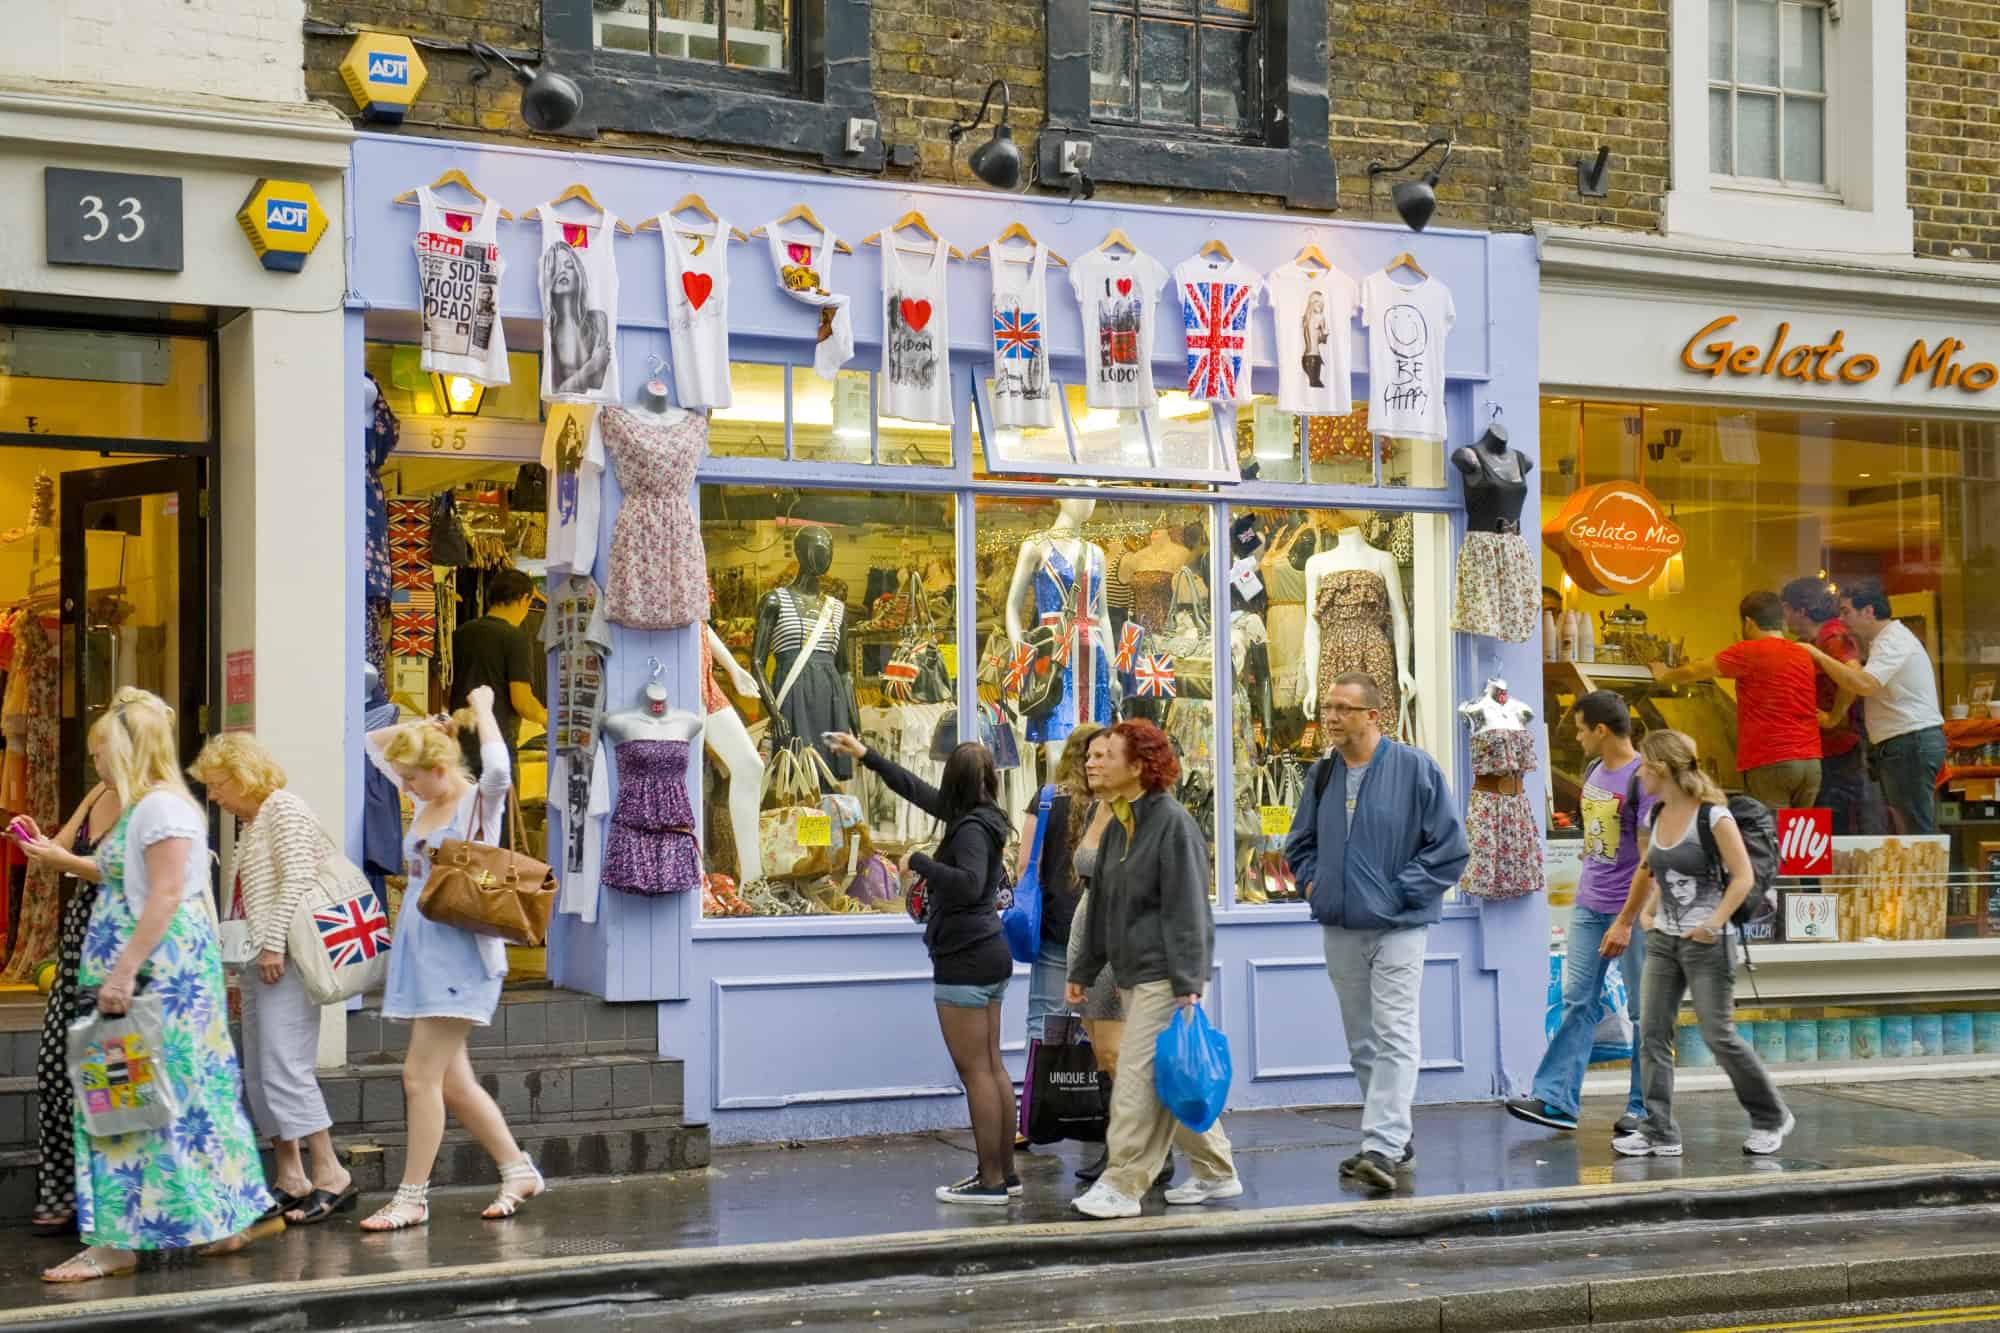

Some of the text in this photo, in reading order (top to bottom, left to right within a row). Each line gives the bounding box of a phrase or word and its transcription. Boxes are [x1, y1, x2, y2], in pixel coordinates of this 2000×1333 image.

[368, 59, 407, 80] ADT
[79, 194, 146, 243] 33
[268, 206, 308, 227] ADT
[449, 261, 475, 283] SID
[426, 297, 472, 321] DEAD
[890, 337, 933, 352] ONDON
[1680, 314, 1999, 392] Gelato Mio
[1391, 359, 1424, 386] BE
[1569, 516, 1680, 544] Gelato Mio
[1781, 816, 1829, 869] illy
[1049, 1071, 1086, 1084] UNIQUE
